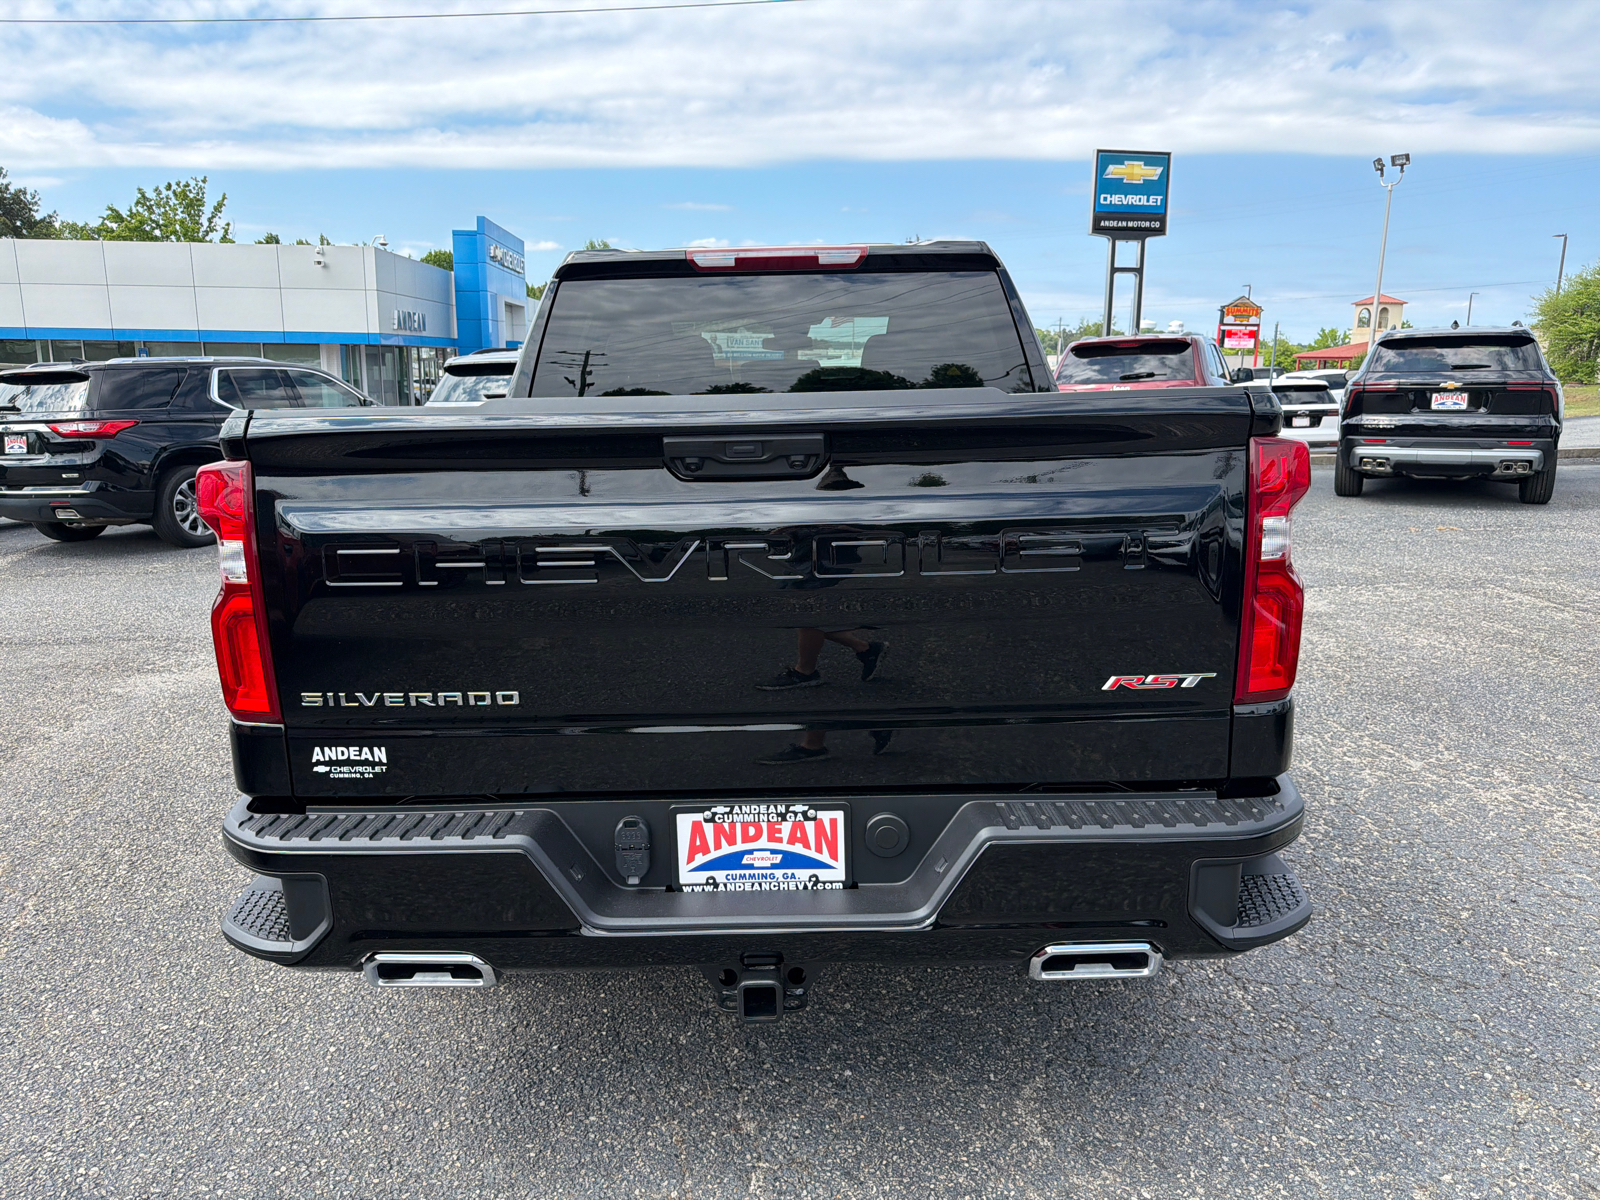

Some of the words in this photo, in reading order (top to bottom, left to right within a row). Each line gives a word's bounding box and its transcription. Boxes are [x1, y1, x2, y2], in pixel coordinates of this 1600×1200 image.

[1100, 194, 1163, 206] CHEVROLET
[1100, 220, 1127, 228] ANDEAN
[1128, 220, 1149, 228] MOTOR
[1225, 306, 1260, 317] SUMMITS
[393, 309, 427, 332] ANDEAN
[1434, 395, 1466, 404] ANDEAN
[322, 524, 1181, 586] CHEVROLET
[1101, 673, 1217, 690] RST
[300, 691, 520, 706] SILVERADO
[312, 746, 387, 763] ANDEAN
[732, 804, 786, 814] ANDEAN
[714, 813, 782, 823] CUMMING,
[786, 813, 804, 821] GA
[686, 817, 839, 866] ANDEAN
[725, 873, 779, 882] CUMMING,
[782, 872, 801, 881] GA.
[682, 880, 844, 893] www.ANDEANCHEVY.com
